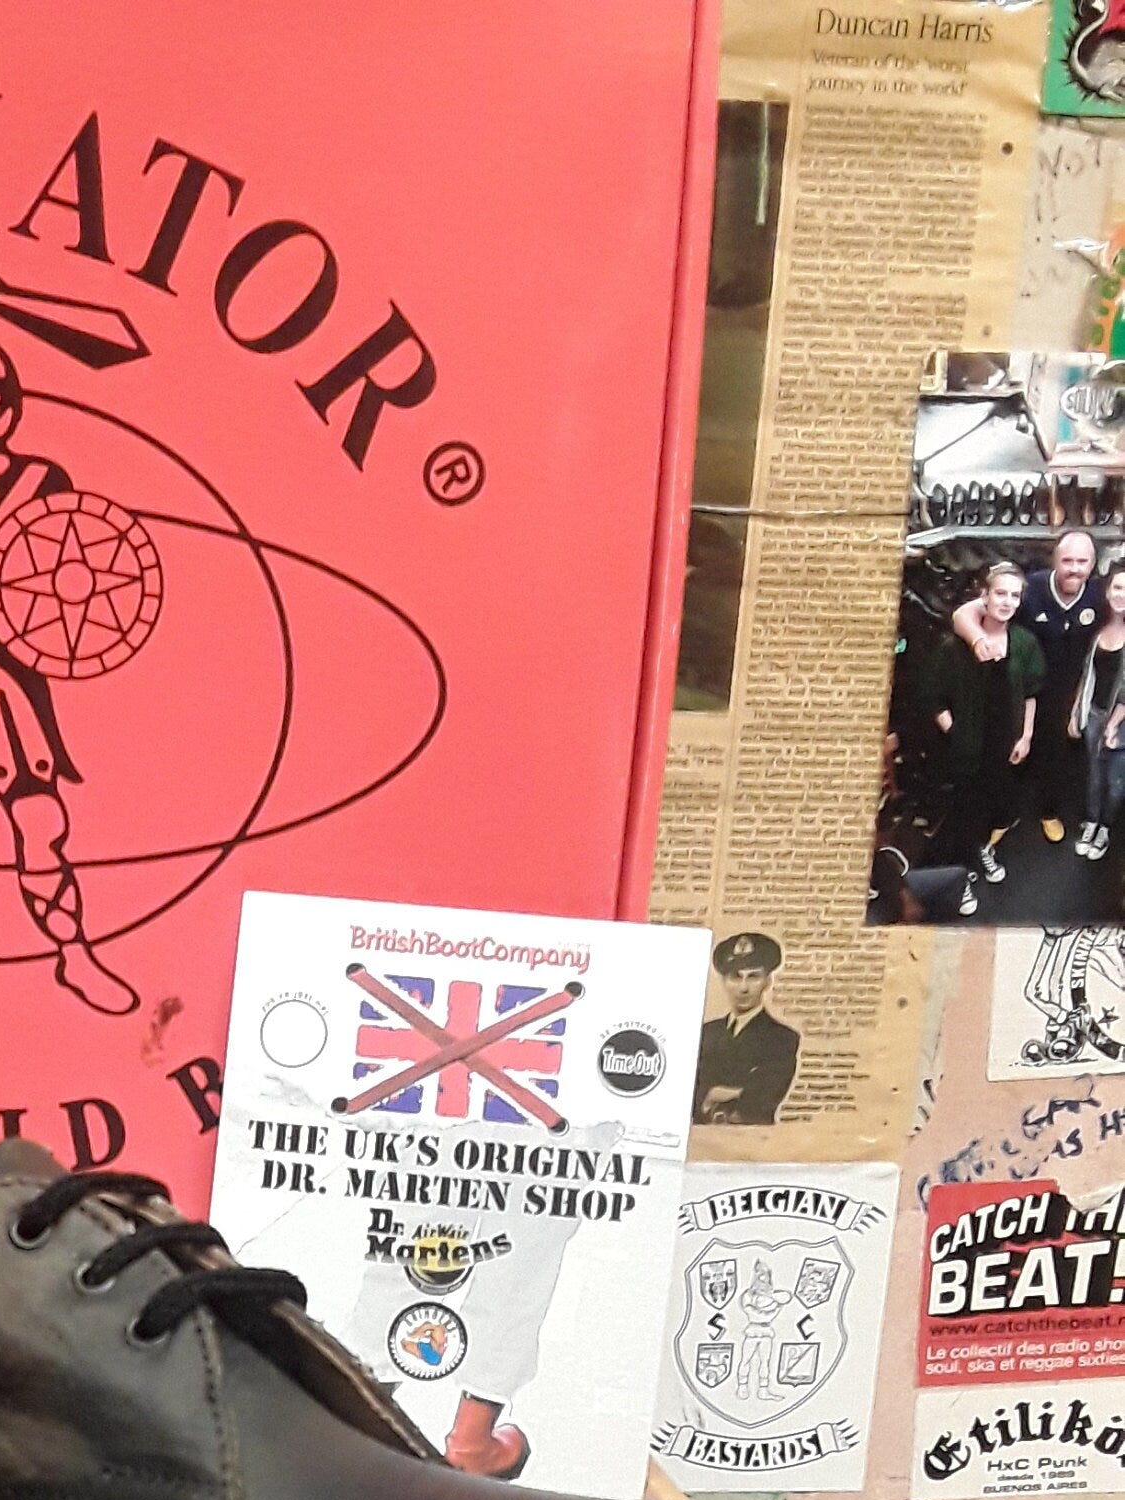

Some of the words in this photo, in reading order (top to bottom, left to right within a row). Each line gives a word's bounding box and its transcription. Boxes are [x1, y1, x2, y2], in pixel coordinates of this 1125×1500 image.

[816, 8, 909, 38] Duncan
[920, 13, 994, 43] Harris
[807, 77, 868, 95] journey
[350, 925, 591, 974] BritishBootCompany
[248, 1120, 329, 1156] THE
[344, 1129, 441, 1168] UK'S
[453, 1138, 652, 1186] ORIGINAL
[261, 1160, 327, 1195] DR.
[344, 1168, 512, 1212] MARTEN
[523, 1185, 636, 1222] SHOP
[715, 1189, 841, 1223] BELGIAN
[368, 1208, 405, 1237] Dr.
[930, 1192, 1051, 1262] CATCH
[1065, 1190, 1125, 1233] TH
[365, 1233, 513, 1267] Martens
[928, 1239, 1125, 1316] BEAT!
[708, 1313, 726, 1341] S
[927, 1346, 945, 1360] Le
[950, 1342, 1012, 1358] collectif
[1016, 1339, 1045, 1354] des
[1049, 1338, 1090, 1353] radio
[1094, 1337, 1125, 1351] sho
[967, 1359, 995, 1373] ska
[1000, 1358, 1015, 1371] et
[1020, 1356, 1074, 1373] reggae
[690, 1432, 819, 1467] BASTARDS
[988, 1457, 1030, 1472] HxC
[1038, 1456, 1088, 1469] Punk
[983, 1482, 1042, 1494] BUENOS
[1047, 1481, 1088, 1491] AIRES
